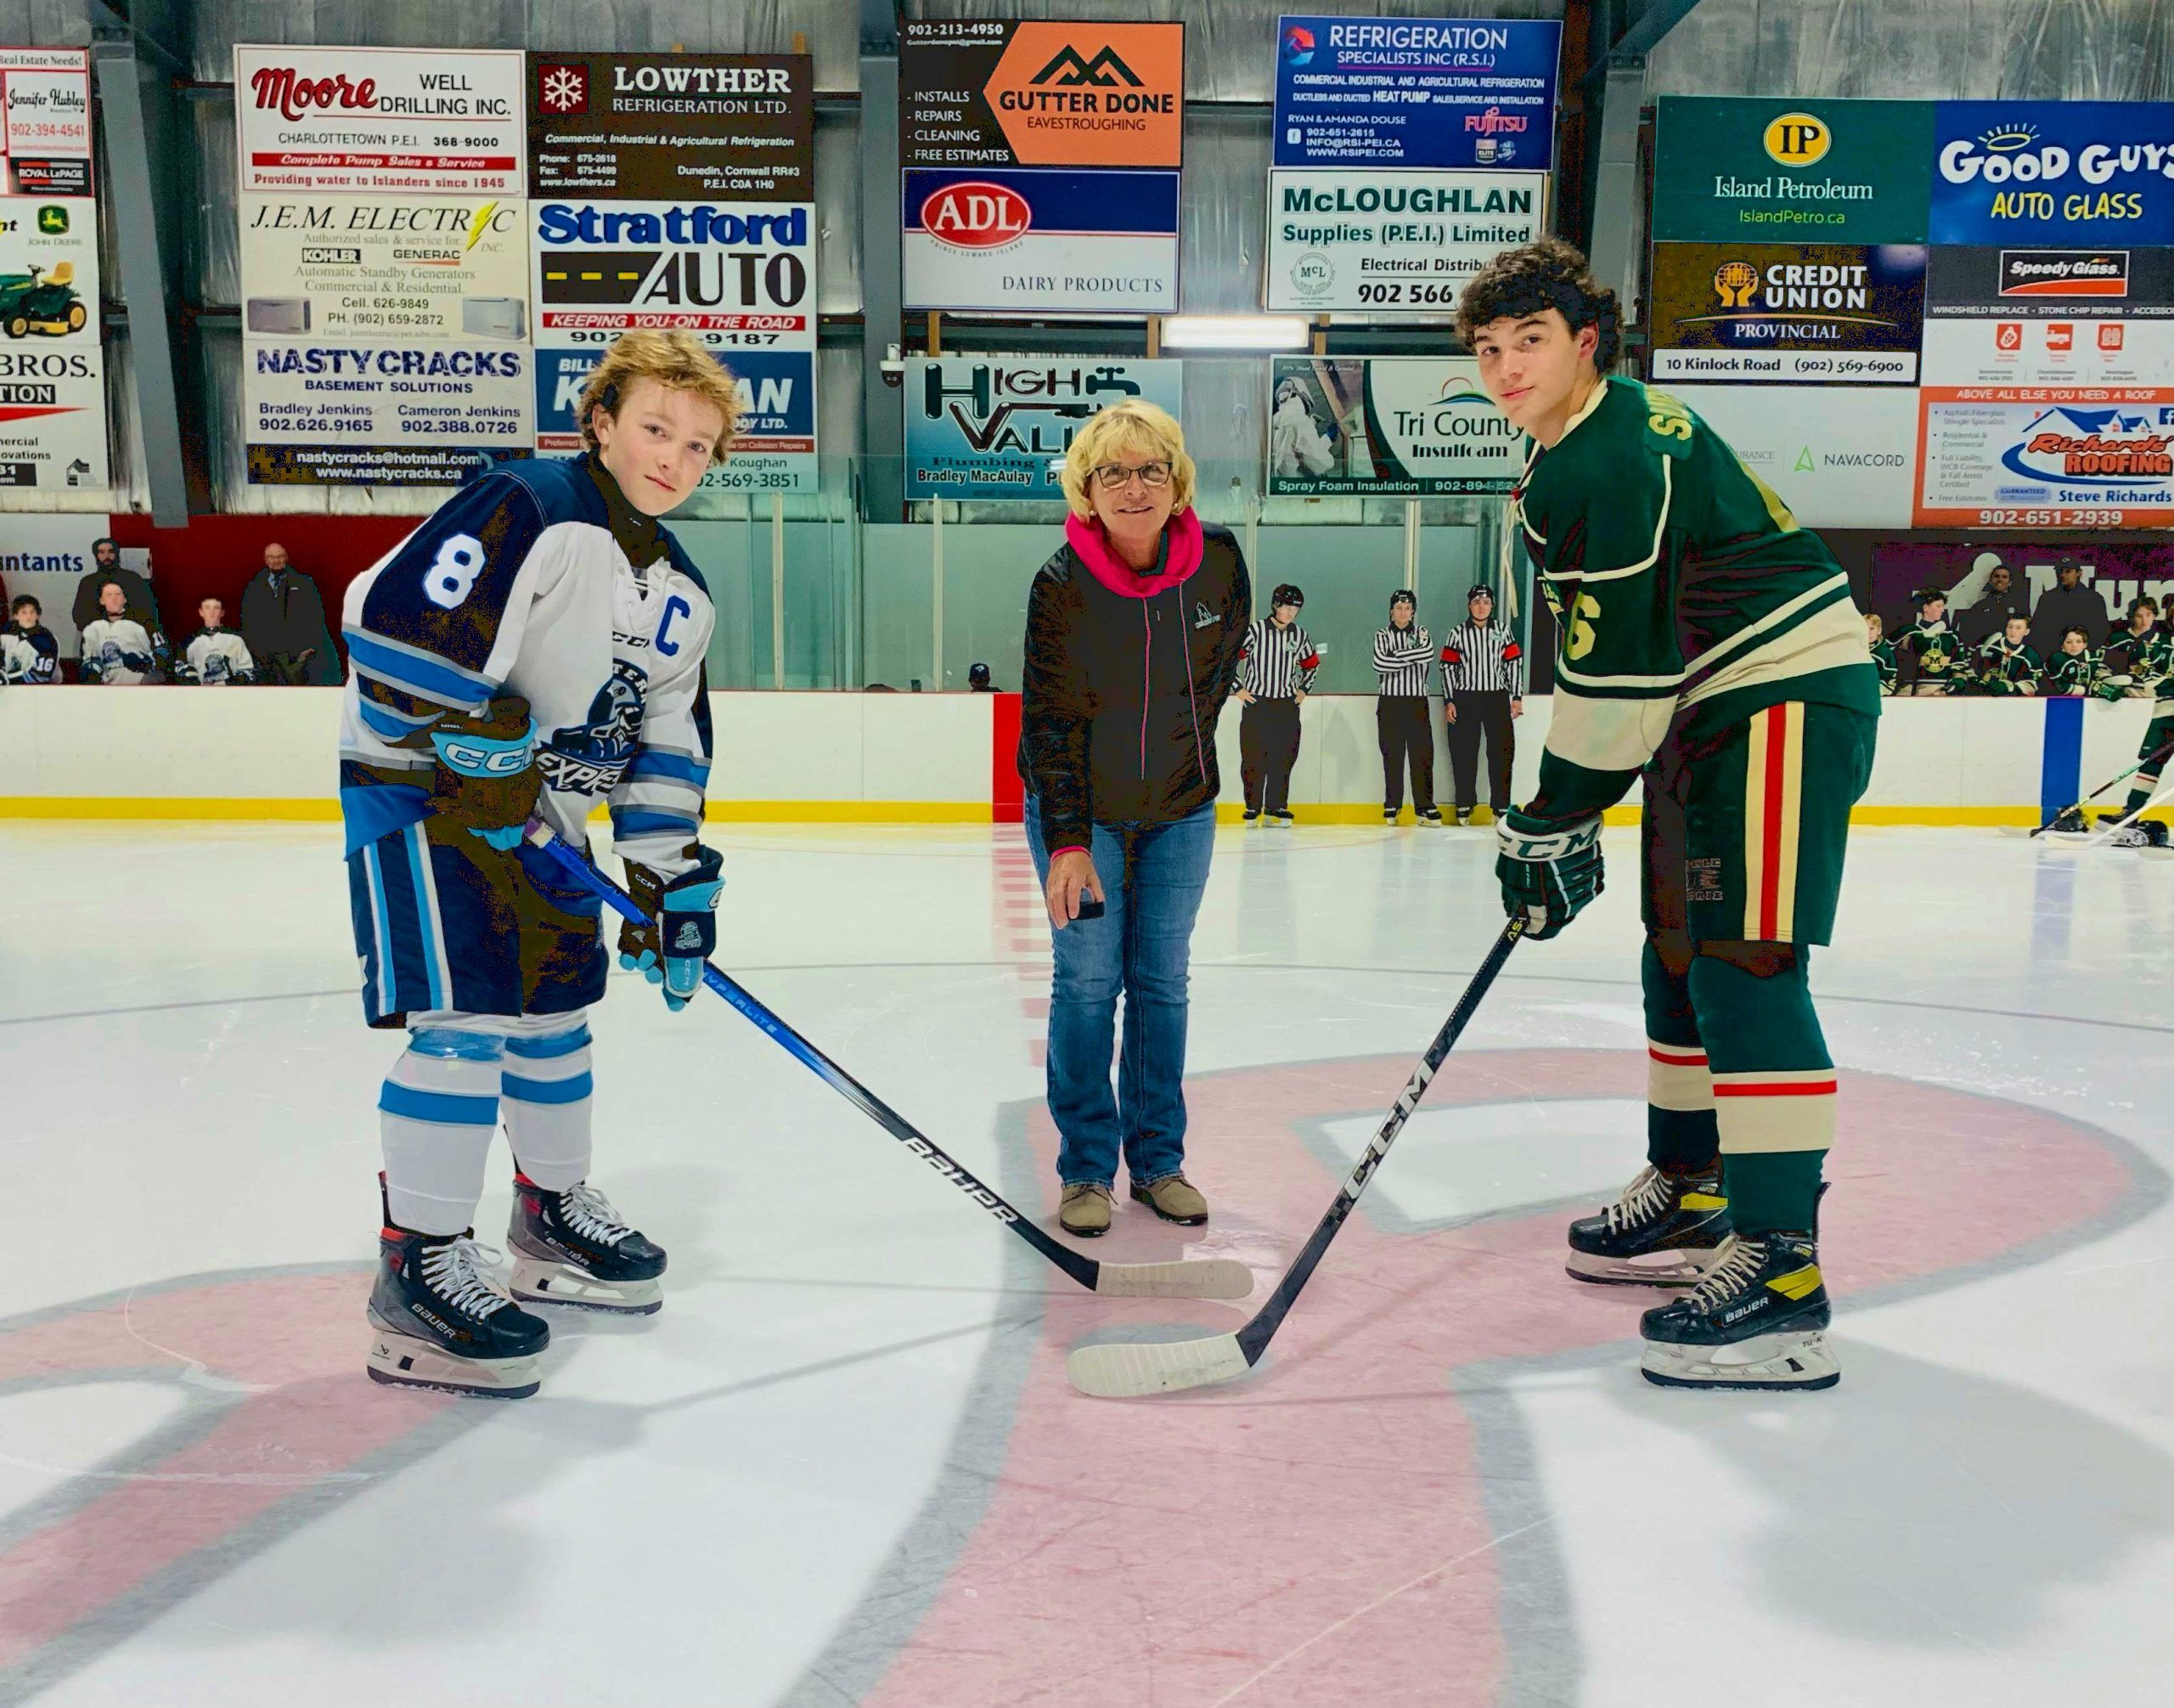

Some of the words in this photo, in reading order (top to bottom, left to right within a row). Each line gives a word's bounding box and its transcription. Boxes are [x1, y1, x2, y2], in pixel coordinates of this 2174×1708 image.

[908, 24, 1004, 35] 902-213-4950
[1330, 25, 1508, 49] REFRIGERATION
[1338, 51, 1422, 65] SPECIALISTS
[1425, 53, 1451, 66] INC
[420, 74, 472, 90] WELL
[615, 66, 791, 93] LOWTHER
[1293, 75, 1347, 85] COMMERCIAL
[1349, 75, 1395, 86] INDUSTRIAL
[1398, 76, 1416, 86] AND
[1418, 76, 1478, 88] AGRICULTURAL
[1480, 78, 1545, 89] REFRIGERATION
[8, 88, 48, 110] Jennifer
[50, 88, 85, 113] Hubley
[251, 68, 378, 121] Moore
[915, 92, 970, 104] INSTALLS
[1328, 93, 1343, 103] AND
[1373, 91, 1401, 103] HEAT
[1402, 92, 1431, 103] PUMP
[381, 97, 467, 115] DRILLING
[476, 99, 511, 116] INC.
[613, 99, 748, 113] REFRIGERATION
[754, 101, 791, 114] LTD.
[1000, 91, 1097, 112] GUTTER
[1106, 93, 1174, 114] DONE
[915, 111, 961, 122] REPAIRS
[1028, 116, 1146, 131] EAVESTROUGHING
[1288, 115, 1314, 123] RYAN
[11, 124, 84, 137] 902-394-4541
[1465, 112, 1528, 137] FUJITSU
[279, 132, 386, 145] CHARLOTTETOWN
[392, 136, 420, 146] P.E.I.
[434, 138, 498, 147] 368-9000
[611, 135, 656, 144] Industrial
[670, 136, 727, 147] Agricultural
[730, 137, 795, 147] Refrigeration
[915, 130, 980, 142] CLEANING
[1779, 125, 1821, 154] IP
[346, 155, 382, 168] Pump
[388, 156, 421, 167] Sales
[437, 158, 486, 169] Service
[915, 149, 943, 161] FREE
[946, 149, 1009, 161] ESTIMATES
[1940, 140, 2070, 184] GOOD
[19, 169, 49, 178] ROYAL
[255, 174, 313, 187] Providing
[317, 176, 350, 185] water
[357, 176, 368, 185] to
[374, 175, 431, 187] Islanders
[436, 178, 468, 188] since
[474, 178, 505, 188] 1945
[1714, 176, 1771, 199] Island
[1777, 178, 1873, 200] Petroleum
[1283, 187, 1531, 214] McLOUGHLAN
[1991, 192, 2054, 221] AUTO
[2064, 192, 2143, 221] GLASS
[251, 206, 335, 229] J.E.M.
[933, 194, 1022, 231] ADL
[1740, 210, 1845, 224] IslandPetro.ca
[538, 205, 807, 246] Stratford
[304, 233, 360, 245] Authorized
[363, 234, 388, 245] sales
[406, 235, 442, 245] service
[1283, 224, 1373, 245] Supplies
[1453, 225, 1529, 243] Limited
[303, 248, 358, 263] KOHLER
[393, 250, 461, 259] GENERAC
[1361, 258, 1428, 271] Electrical
[295, 267, 356, 278] Automatic
[360, 267, 408, 279] Standby
[411, 268, 476, 279] Generators
[643, 252, 807, 307] AUTO
[1766, 264, 1867, 286] CREDIT
[305, 280, 378, 292] Commercial
[1003, 276, 1057, 290] DAIRY
[1065, 278, 1163, 293] PRODUCTS
[1358, 285, 1401, 303] 902
[1410, 285, 1453, 303] 566
[1765, 287, 1866, 309] UNION
[375, 299, 429, 309] 626-9849
[1933, 306, 1988, 315] WINDSHIELD
[1990, 306, 2029, 315] REPLACE
[2038, 307, 2068, 315] STONE
[2070, 307, 2090, 315] CHIP
[2092, 307, 2123, 315] REPAIR
[329, 313, 349, 324] PH.
[353, 313, 385, 325] (902)
[389, 314, 443, 325] 659-2872
[551, 313, 628, 327] KEEPING
[673, 315, 702, 328] ON
[708, 316, 741, 329] THE
[743, 316, 797, 330] ROAD
[1735, 323, 1841, 340] PROVINCIAL
[0, 354, 96, 377] BROS.
[256, 348, 374, 374] NASTY
[377, 350, 521, 377] CRACKS
[1667, 359, 1681, 370] 10
[1686, 358, 1740, 371] Kinlock
[1743, 358, 1781, 371] Road
[1794, 358, 1833, 373] (902)
[1837, 360, 1903, 374] 569-6900
[306, 380, 383, 392] BASEMENT
[391, 382, 473, 393] SOLUTIONS
[925, 364, 1080, 420] HIGH
[1957, 389, 1993, 400] ABOVE
[1998, 390, 2016, 400] ALL
[2020, 390, 2047, 400] ELSE
[2050, 390, 2075, 400] YOU
[2079, 390, 2109, 400] NEED
[2125, 391, 2156, 400] ROOF
[260, 403, 313, 416] Bradley
[318, 403, 373, 415] Jenkins
[397, 405, 461, 417] Cameron
[466, 406, 521, 418] Jenkins
[260, 419, 373, 431] 902.626.9165
[402, 420, 517, 434] 902.388.0726
[1394, 411, 1424, 437] Tri
[1434, 412, 1524, 442] County
[297, 451, 480, 466] nastycracks@hotmail.com
[730, 457, 787, 471] Koughan
[933, 456, 1035, 469] Plumbing
[1825, 454, 1905, 468] NAVACORD
[2065, 454, 2173, 476] ROOFING
[316, 466, 462, 480] www.nastycracks.ca
[917, 470, 966, 485] Bradley
[971, 471, 1033, 486] MacAulay
[1279, 481, 1315, 492] Spray
[1319, 481, 1354, 491] Foam
[1357, 480, 1419, 491] Insulation
[2059, 490, 2101, 503] Steve
[2105, 490, 2171, 504] Richards
[1980, 510, 2123, 525] 902-651-2939
[422, 533, 487, 611] 8
[654, 595, 691, 657] C
[635, 873, 656, 890] CCM
[1344, 1059, 1435, 1200] CCM
